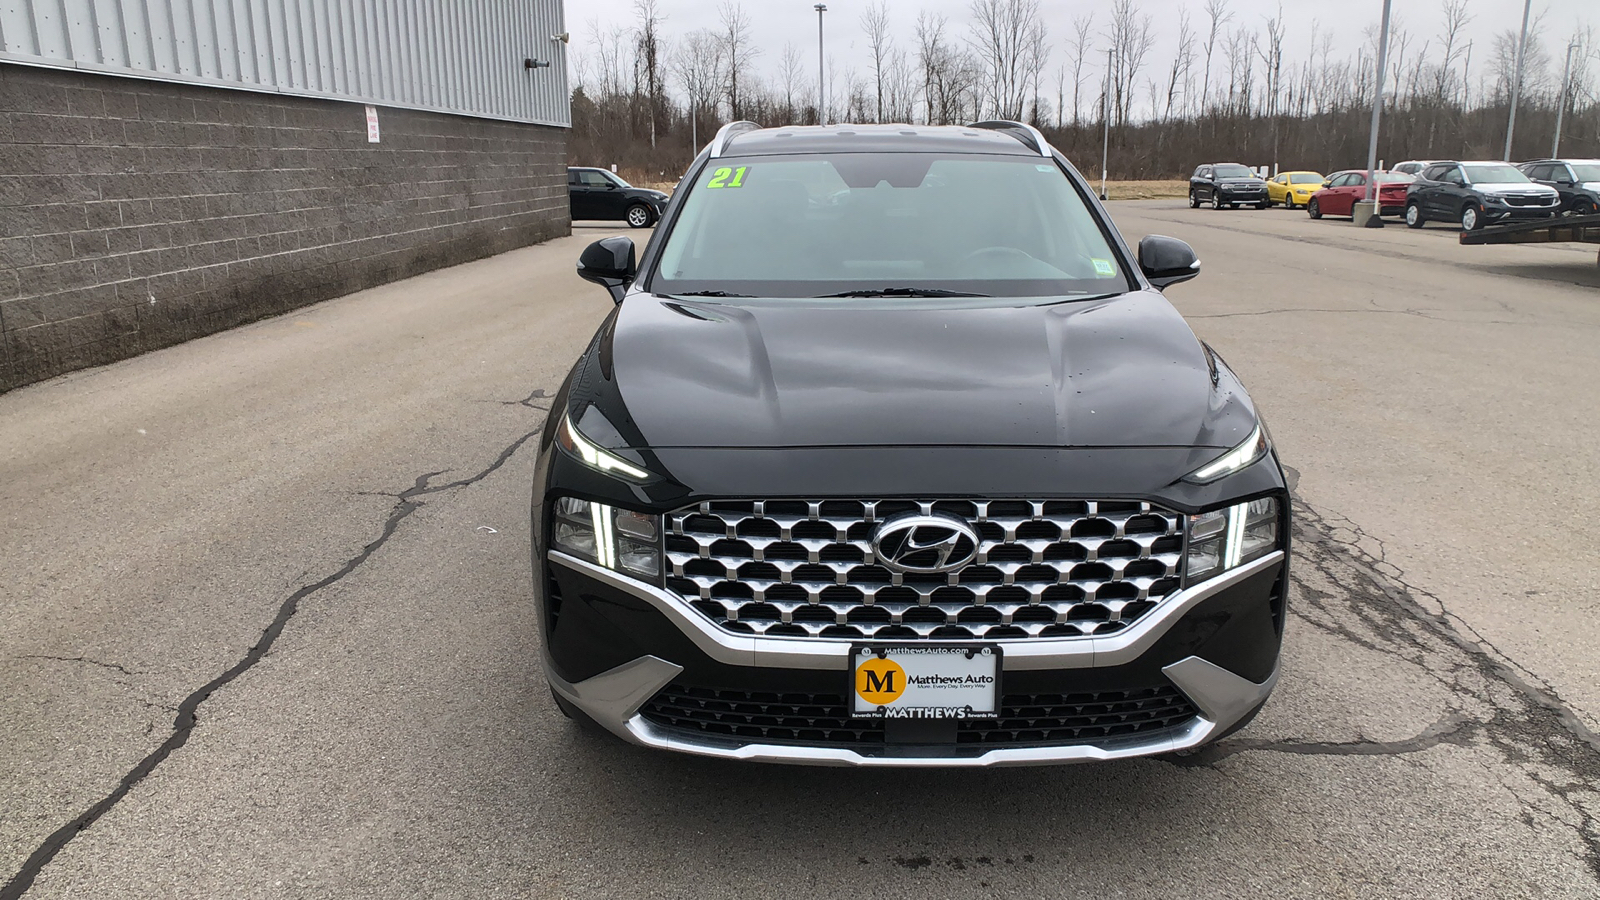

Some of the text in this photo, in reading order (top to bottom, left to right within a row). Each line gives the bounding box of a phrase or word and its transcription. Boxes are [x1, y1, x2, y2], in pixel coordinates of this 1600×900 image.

[707, 166, 746, 188] 21
[884, 647, 969, 655] MatthewsAuto.com
[862, 669, 897, 693] M
[908, 674, 994, 684] Matthews Auto
[884, 707, 966, 719] MATTHEWS
